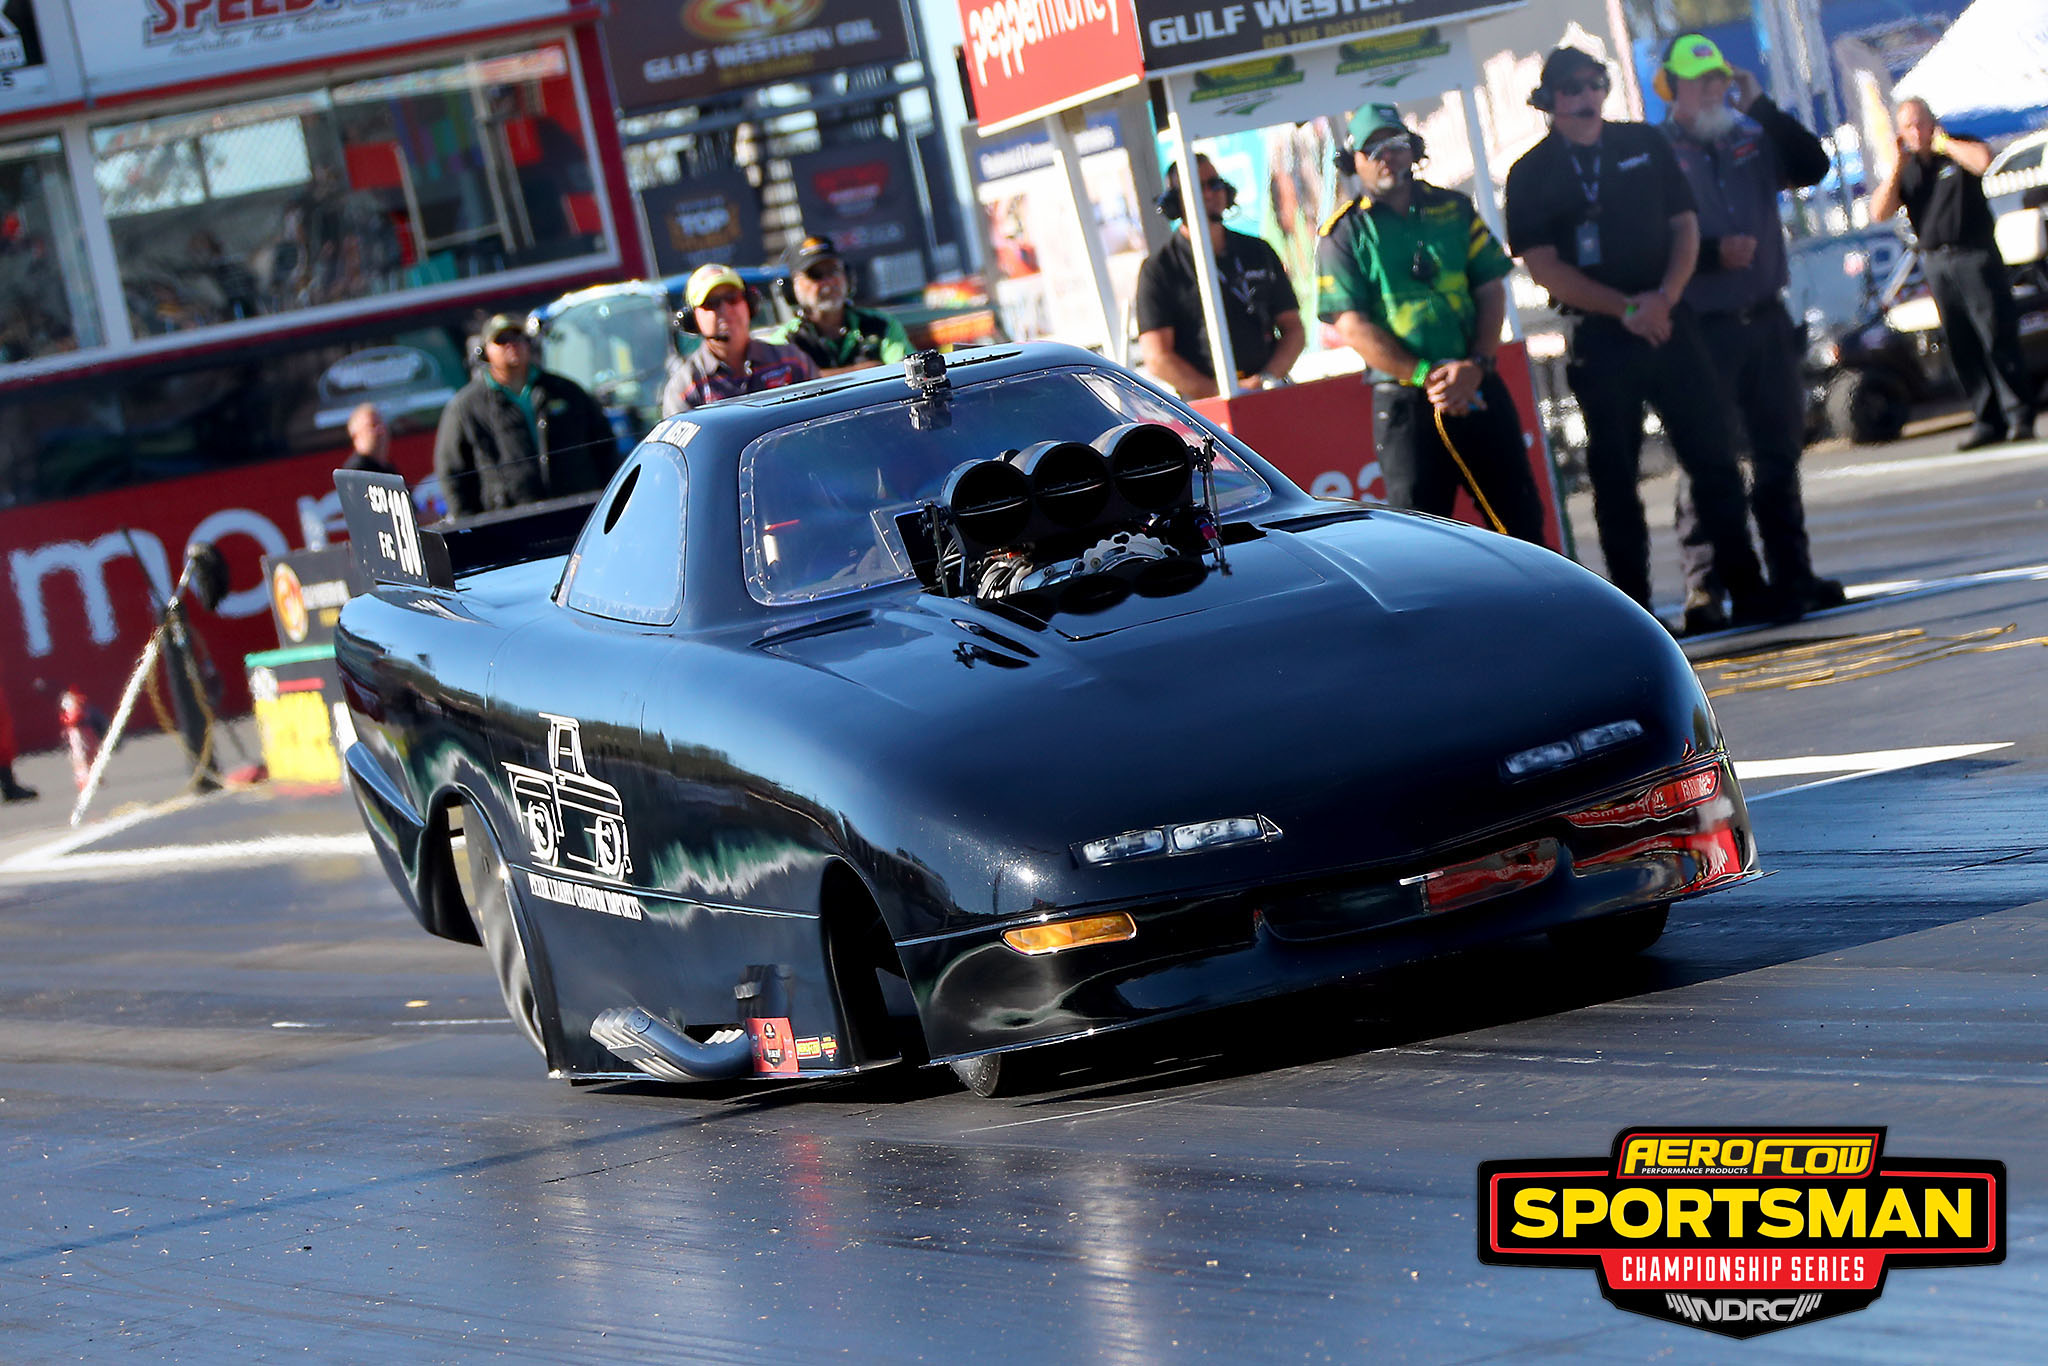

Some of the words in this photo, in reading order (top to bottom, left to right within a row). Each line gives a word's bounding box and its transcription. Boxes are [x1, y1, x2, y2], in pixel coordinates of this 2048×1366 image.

[643, 50, 708, 82] GULF
[713, 27, 833, 67] WESTERN
[835, 18, 879, 45] OIL
[1150, 5, 1246, 47] GULF
[1253, 0, 1412, 28] WEST
[388, 488, 423, 576] 130
[574, 883, 609, 913] CUSTOM
[603, 890, 642, 921] IMPORTS
